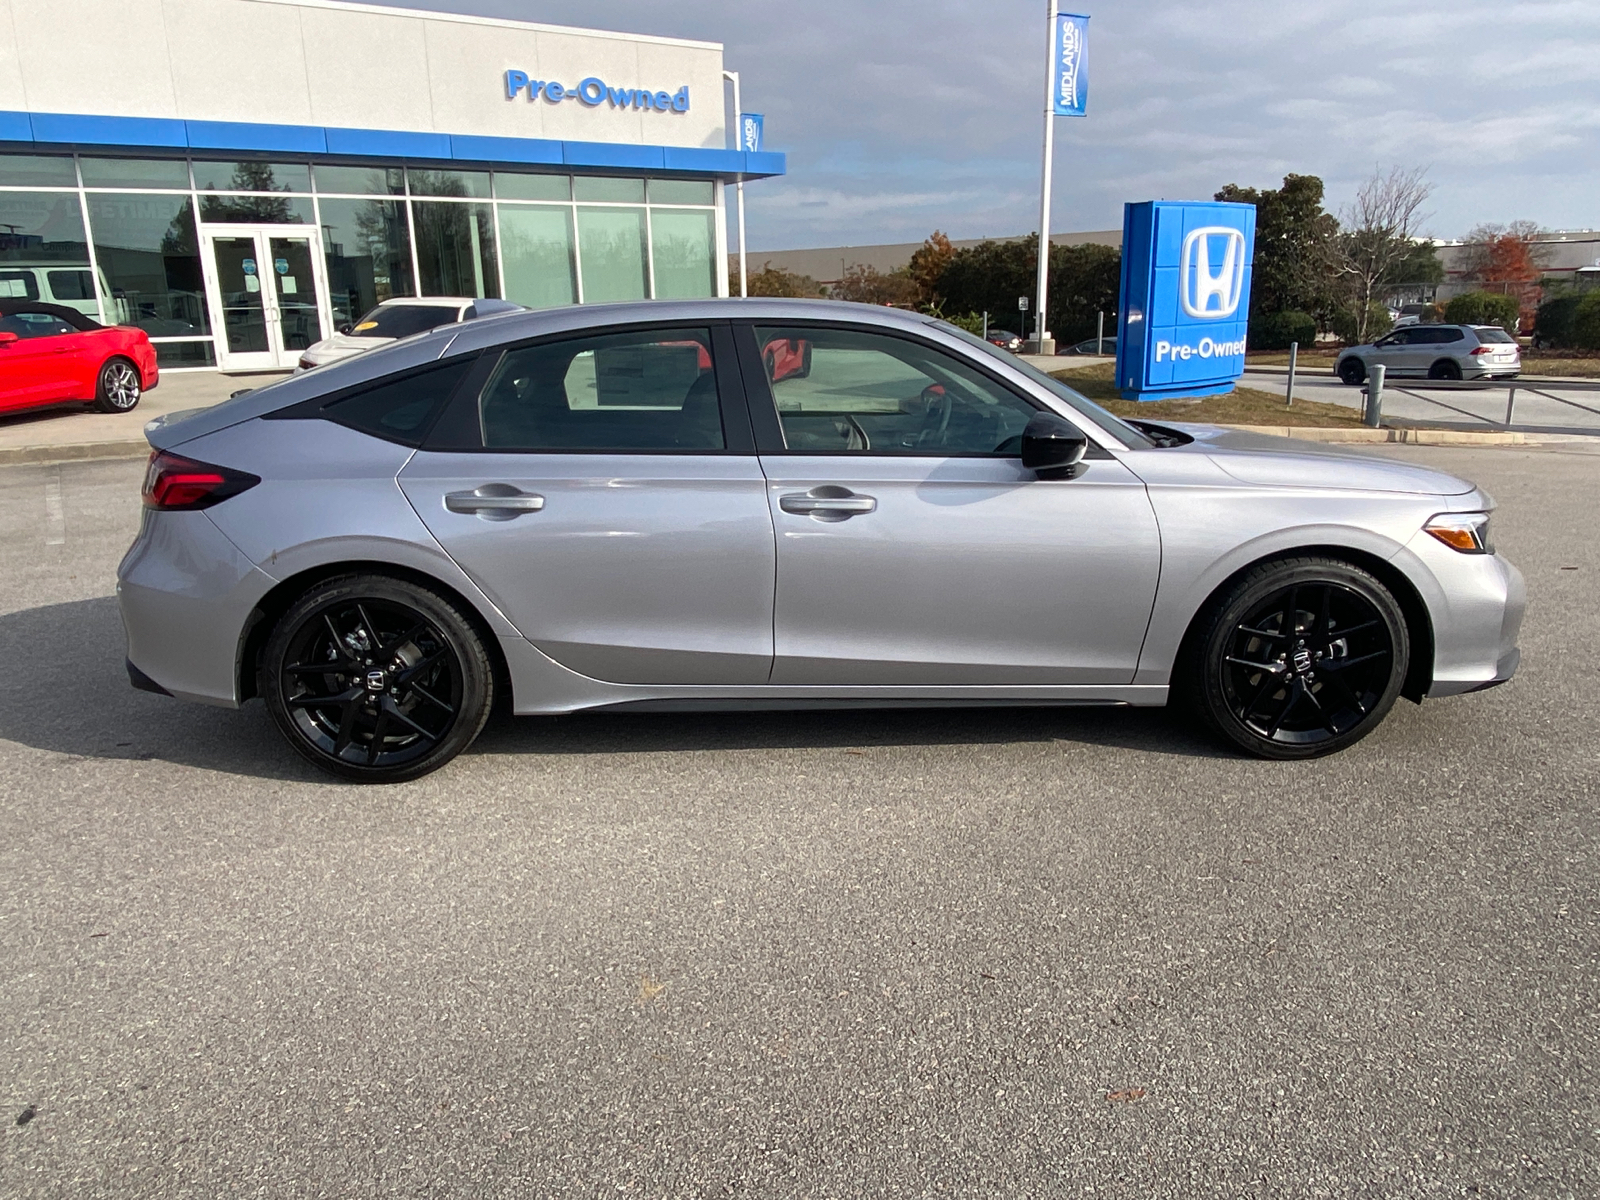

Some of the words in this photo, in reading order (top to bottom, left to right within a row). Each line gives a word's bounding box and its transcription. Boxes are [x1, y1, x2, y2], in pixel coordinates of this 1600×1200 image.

[1060, 21, 1075, 106] MIDLANDS
[504, 69, 691, 112] Pre-Owned
[1155, 335, 1247, 363] Pre-Owned
